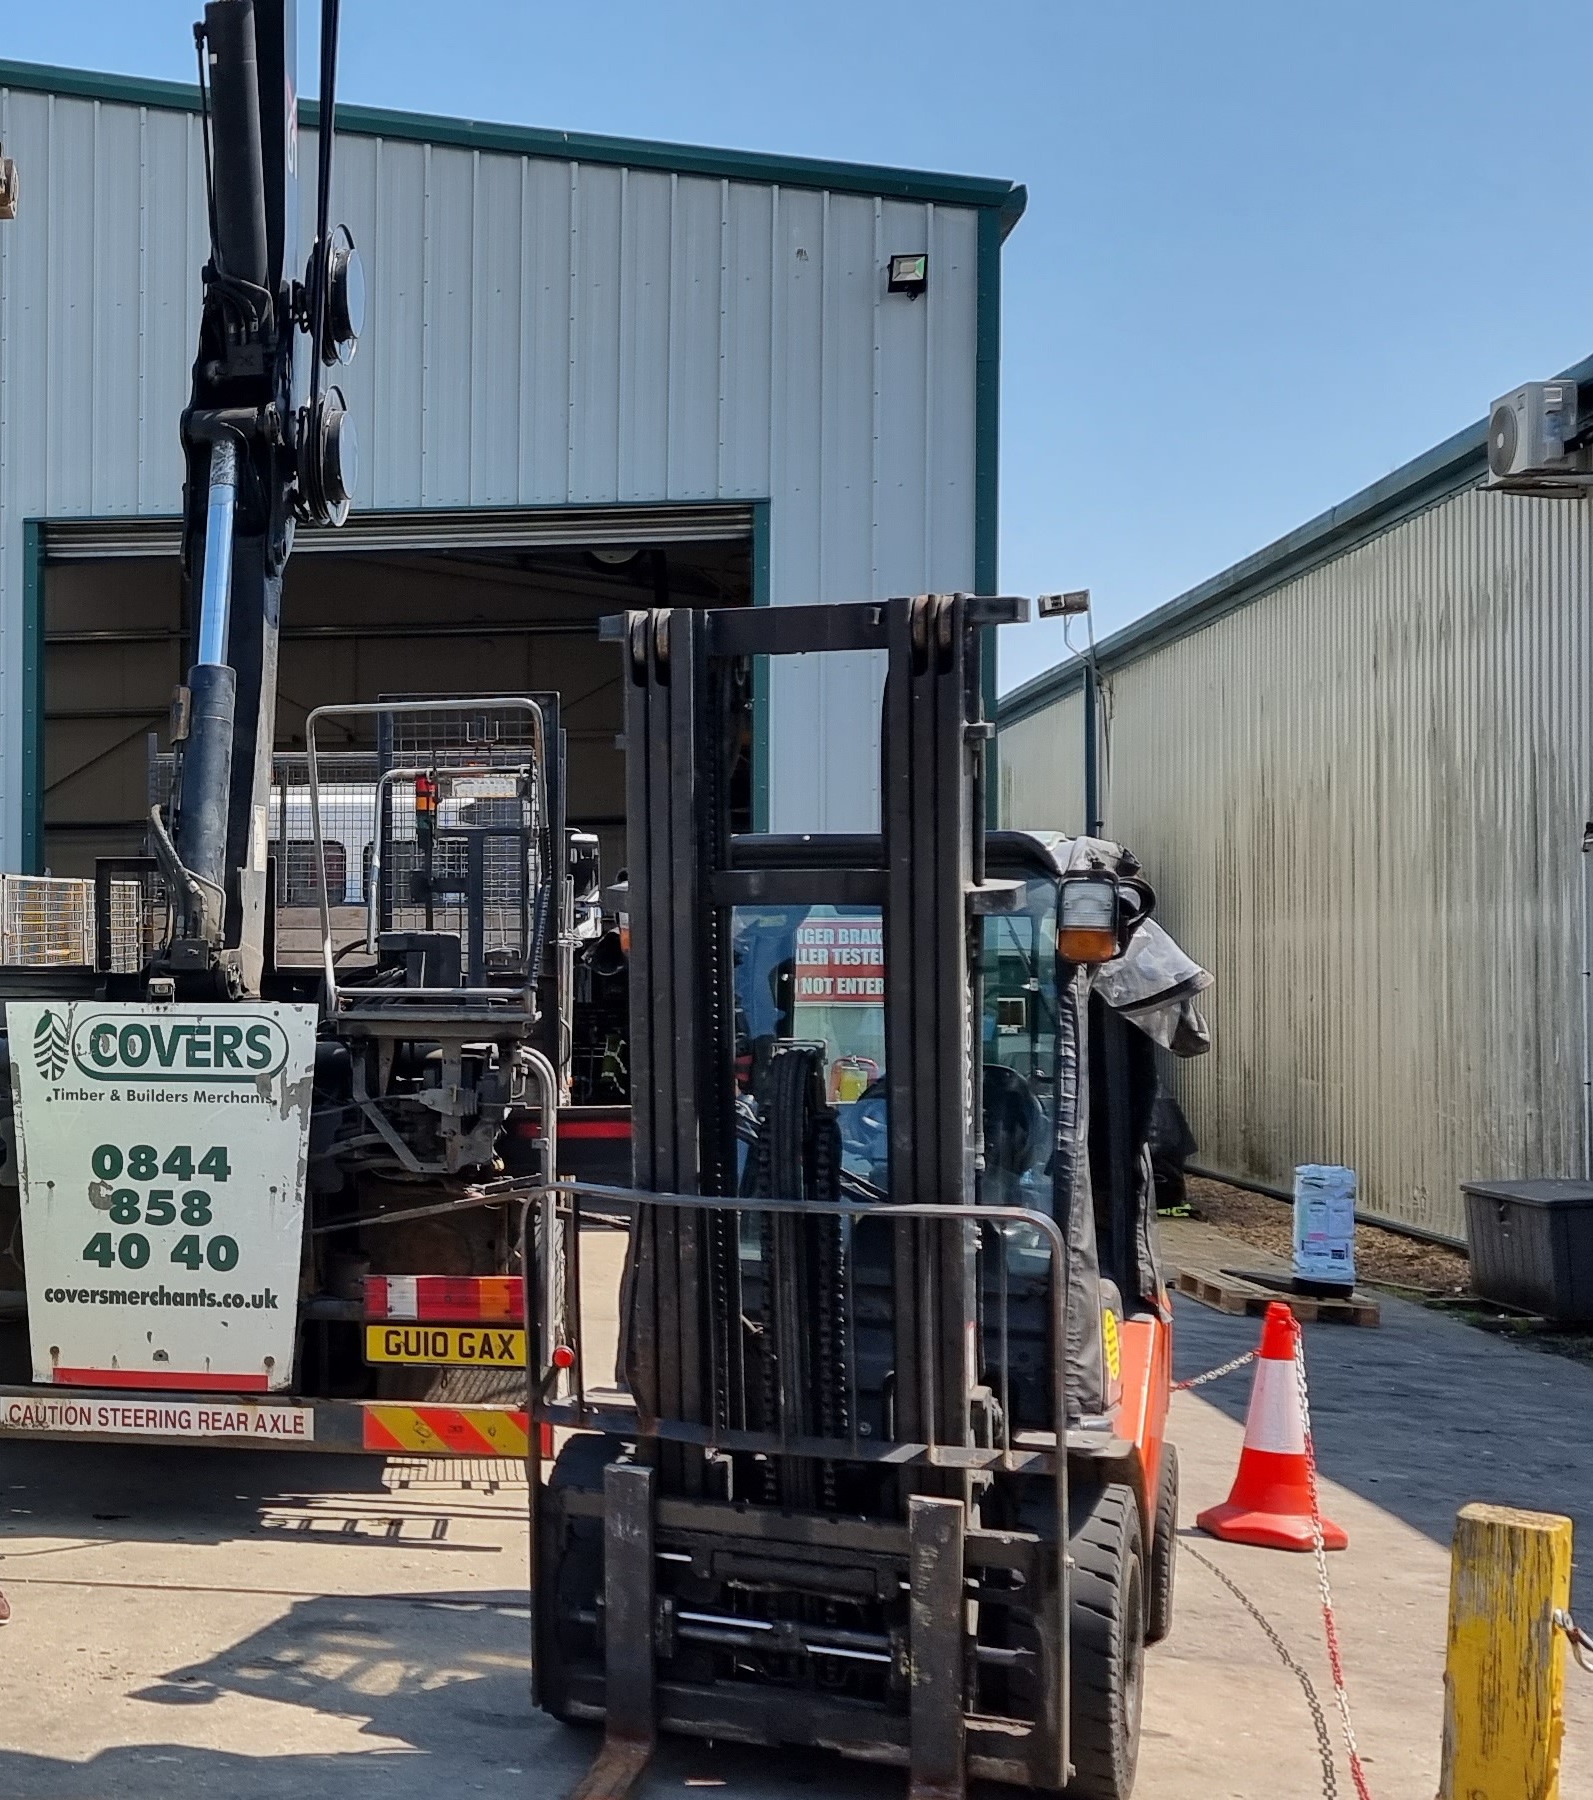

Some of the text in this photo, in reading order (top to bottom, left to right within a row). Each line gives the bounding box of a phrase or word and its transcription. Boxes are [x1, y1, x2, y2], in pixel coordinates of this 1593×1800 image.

[801, 977, 834, 994] NOT
[837, 977, 884, 994] ENTER
[90, 1022, 273, 1069] COVERS
[52, 1087, 105, 1102] Timber
[110, 1089, 121, 1102] &
[126, 1088, 188, 1104] Builders
[91, 1144, 232, 1182] 0844
[109, 1188, 212, 1227] 858
[82, 1232, 239, 1272] 40 40
[44, 1285, 278, 1310] coversmerchants.co.uk
[385, 1330, 515, 1360] GU10 GAX
[8, 1404, 305, 1435] CAUTION STEERING REAR AXLE
